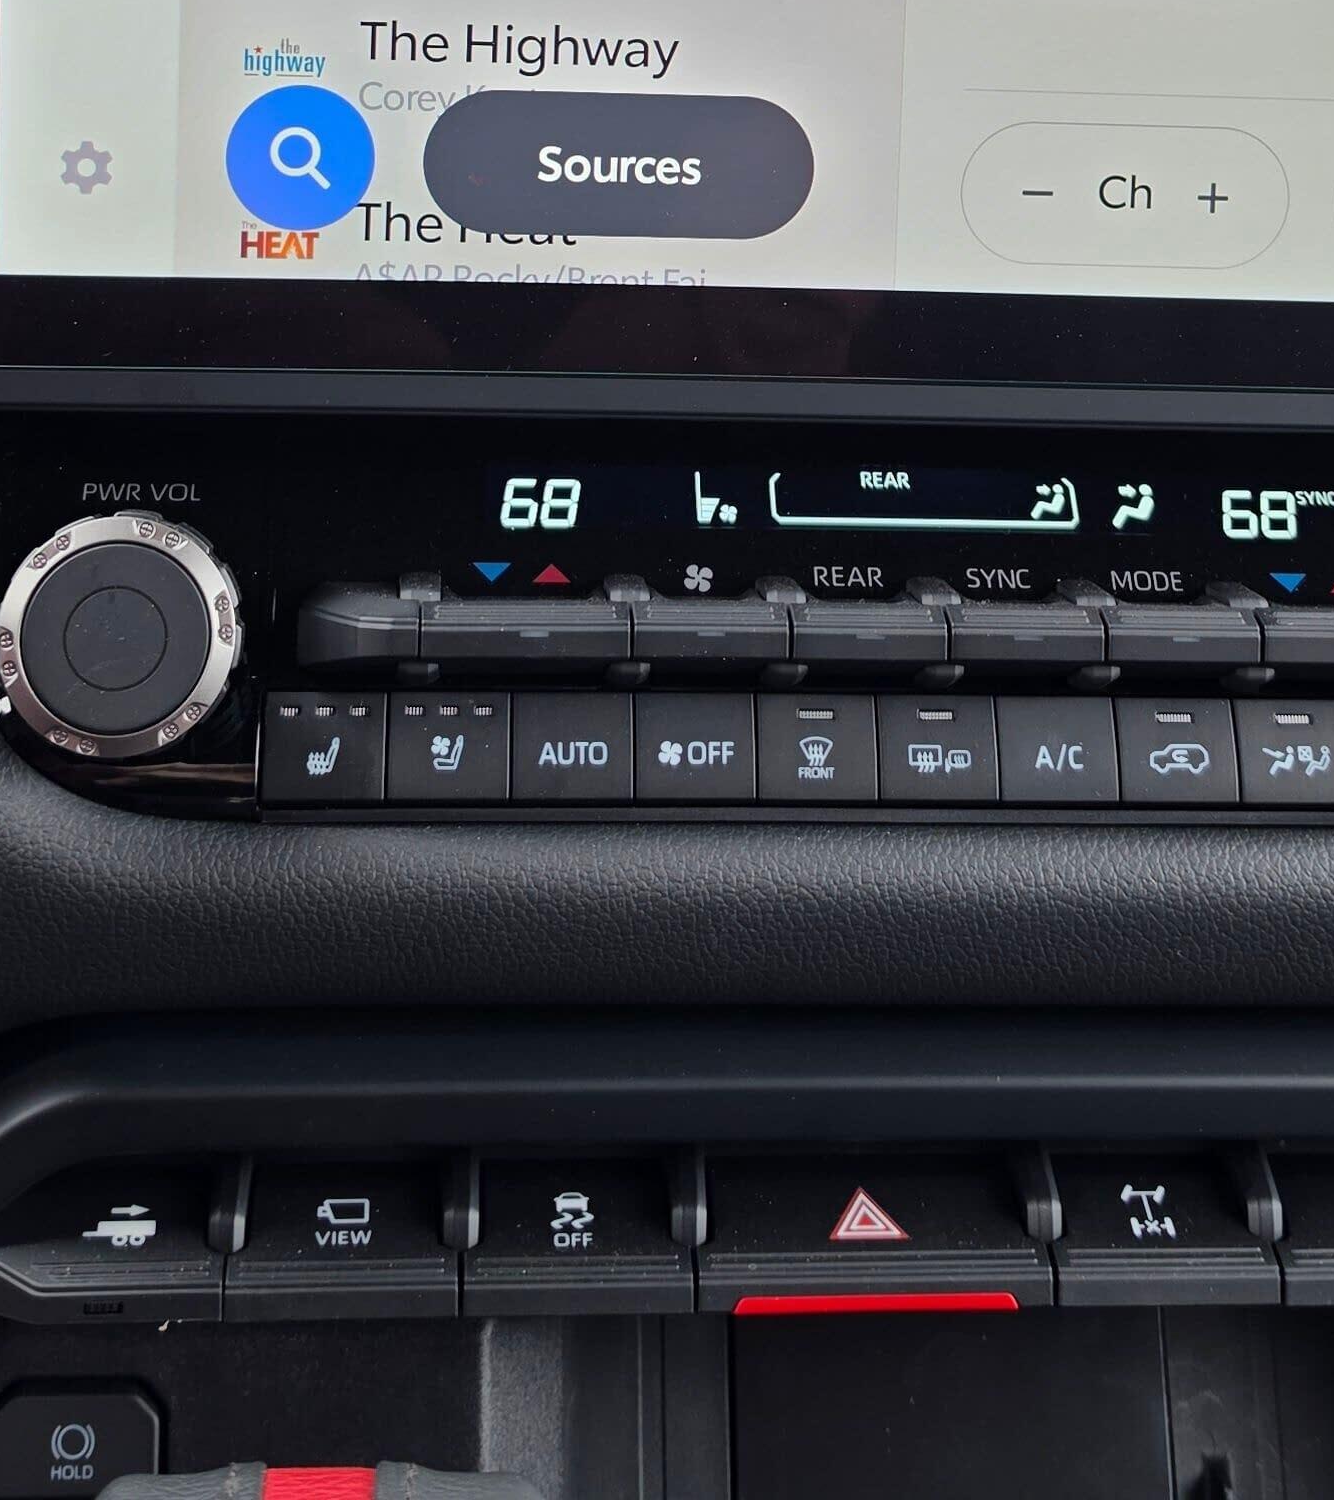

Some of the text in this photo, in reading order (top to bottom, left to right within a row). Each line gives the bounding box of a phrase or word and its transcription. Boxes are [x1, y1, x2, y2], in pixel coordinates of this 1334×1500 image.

[280, 38, 300, 55] the
[361, 21, 680, 79] The Highway
[244, 48, 326, 77] highway
[358, 81, 456, 113] Corey
[538, 145, 702, 186] Sources
[1098, 174, 1153, 212] Ch
[357, 201, 443, 243] The
[240, 231, 320, 260] HEAT
[81, 483, 202, 503] PWR VOL
[859, 470, 911, 491] REAR
[499, 477, 583, 530] 68
[1222, 489, 1298, 540] 68
[813, 565, 885, 589] REAR
[966, 568, 1031, 591] SYNC
[1111, 570, 1185, 594] MODE
[538, 741, 609, 768] AUTO
[687, 741, 735, 768] OFF
[1035, 744, 1085, 772] A/C
[797, 766, 836, 780] FRONT
[314, 1229, 373, 1247] VIEW
[553, 1231, 594, 1249] OFF
[50, 1464, 94, 1481] HOLD
